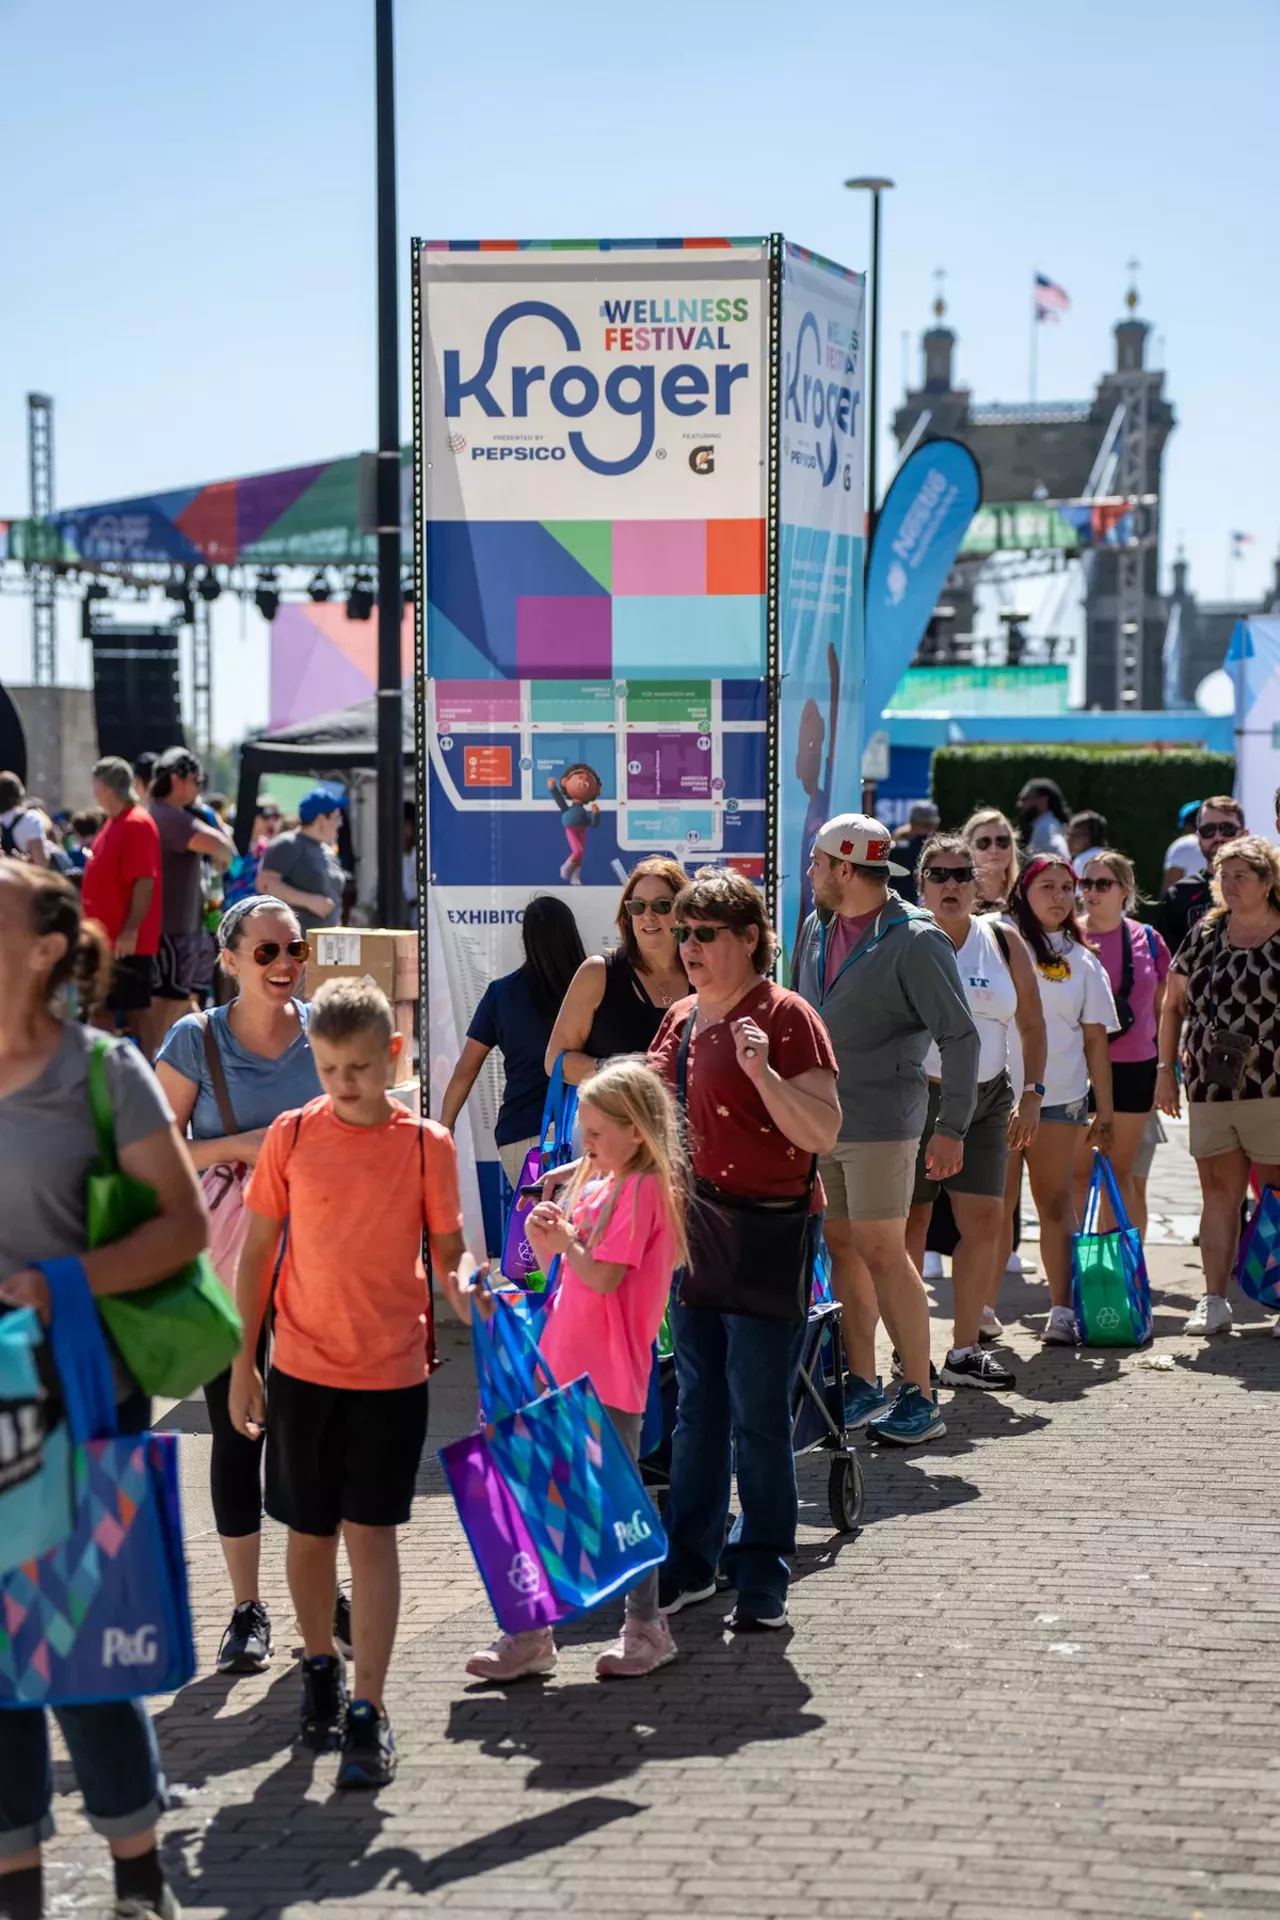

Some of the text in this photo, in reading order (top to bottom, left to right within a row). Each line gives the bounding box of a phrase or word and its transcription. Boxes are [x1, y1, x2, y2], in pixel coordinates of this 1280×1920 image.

[604, 297, 749, 324] WELLNESS
[604, 326, 731, 351] FESTIVAL
[443, 300, 749, 477] Kroger
[785, 310, 861, 488] Kroger
[682, 432, 722, 440] FEATURING
[471, 446, 566, 461] PEPSICO
[688, 444, 715, 475] G
[968, 977, 990, 988] IT
[612, 1508, 653, 1553] P&G
[101, 1623, 159, 1668] P&G
